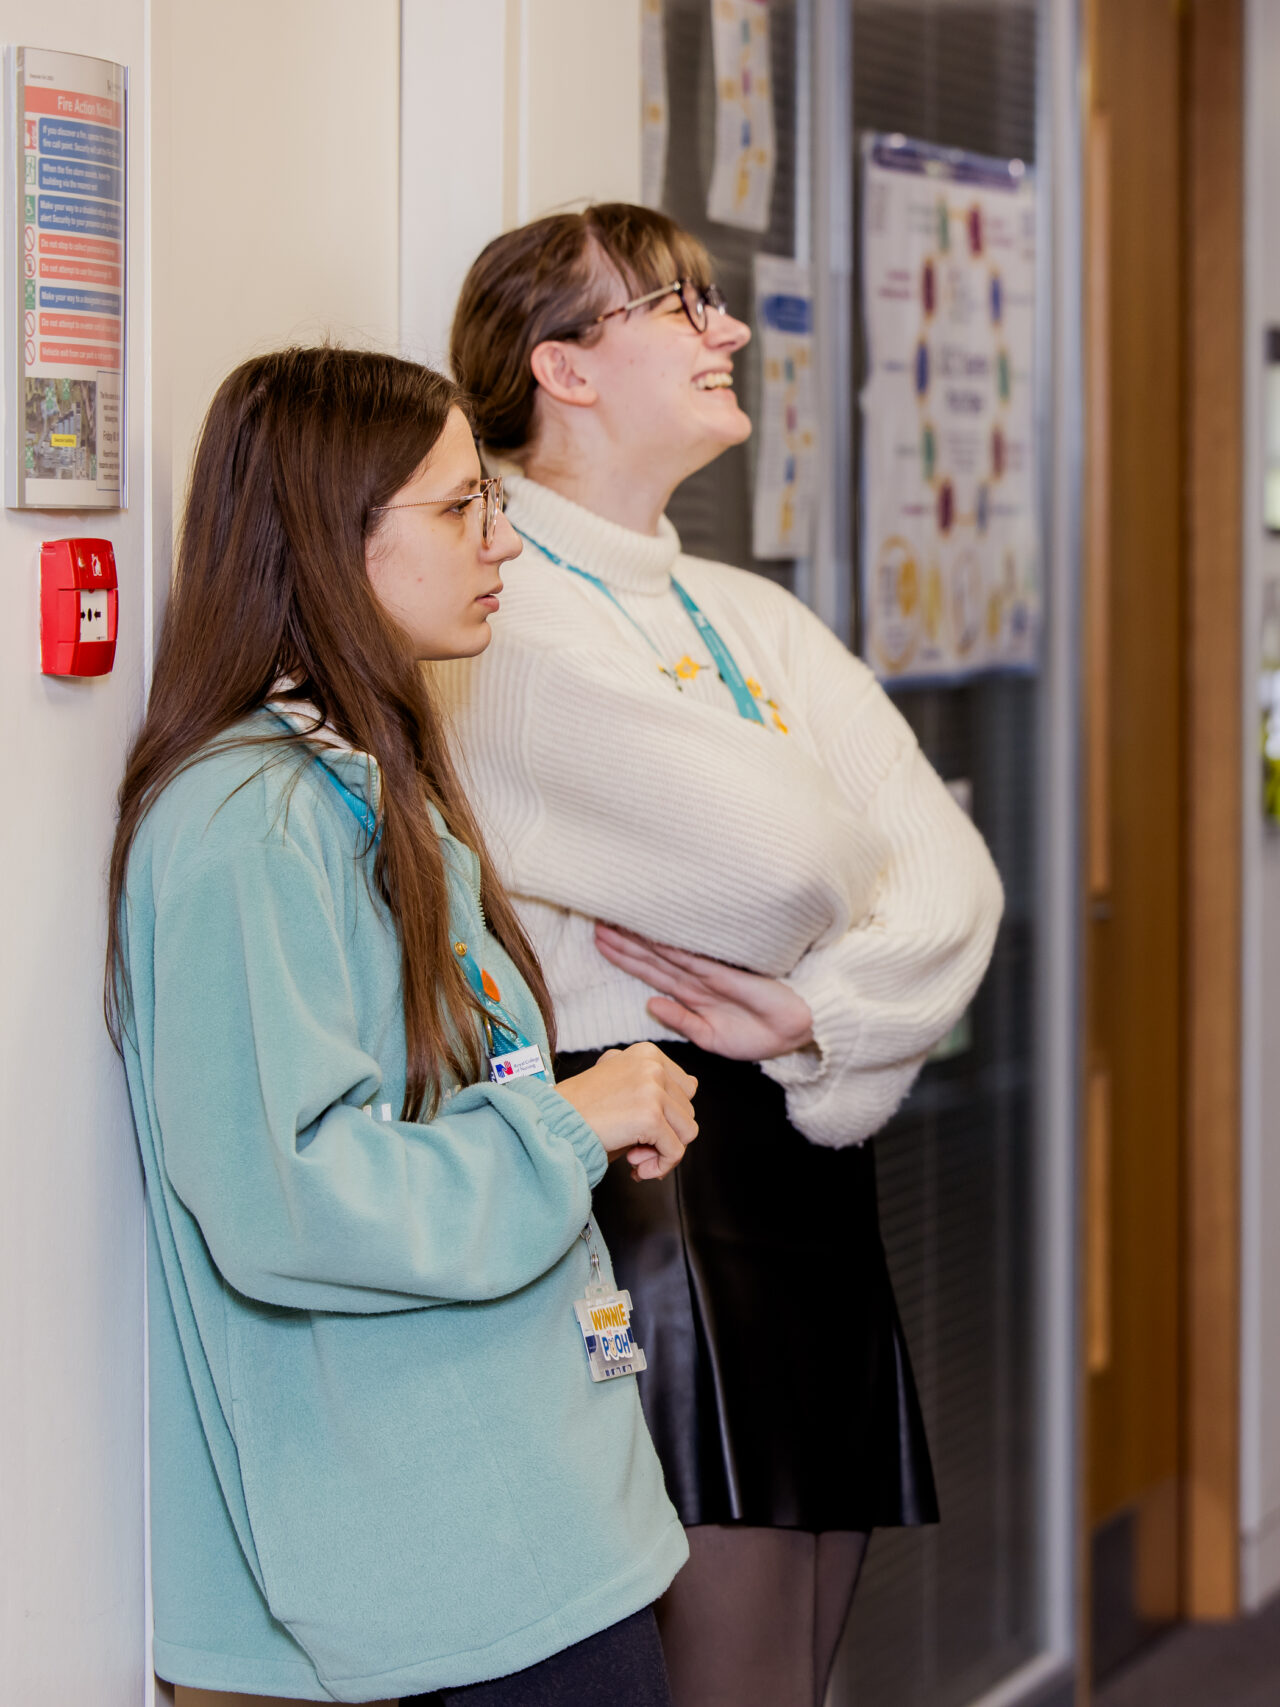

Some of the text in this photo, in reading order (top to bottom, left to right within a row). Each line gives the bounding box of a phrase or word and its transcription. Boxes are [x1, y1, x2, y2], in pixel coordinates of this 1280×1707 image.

[58, 95, 73, 112] Fire
[74, 99, 95, 115] Action
[590, 1303, 628, 1331] WINNIE
[602, 1334, 631, 1356] POH
